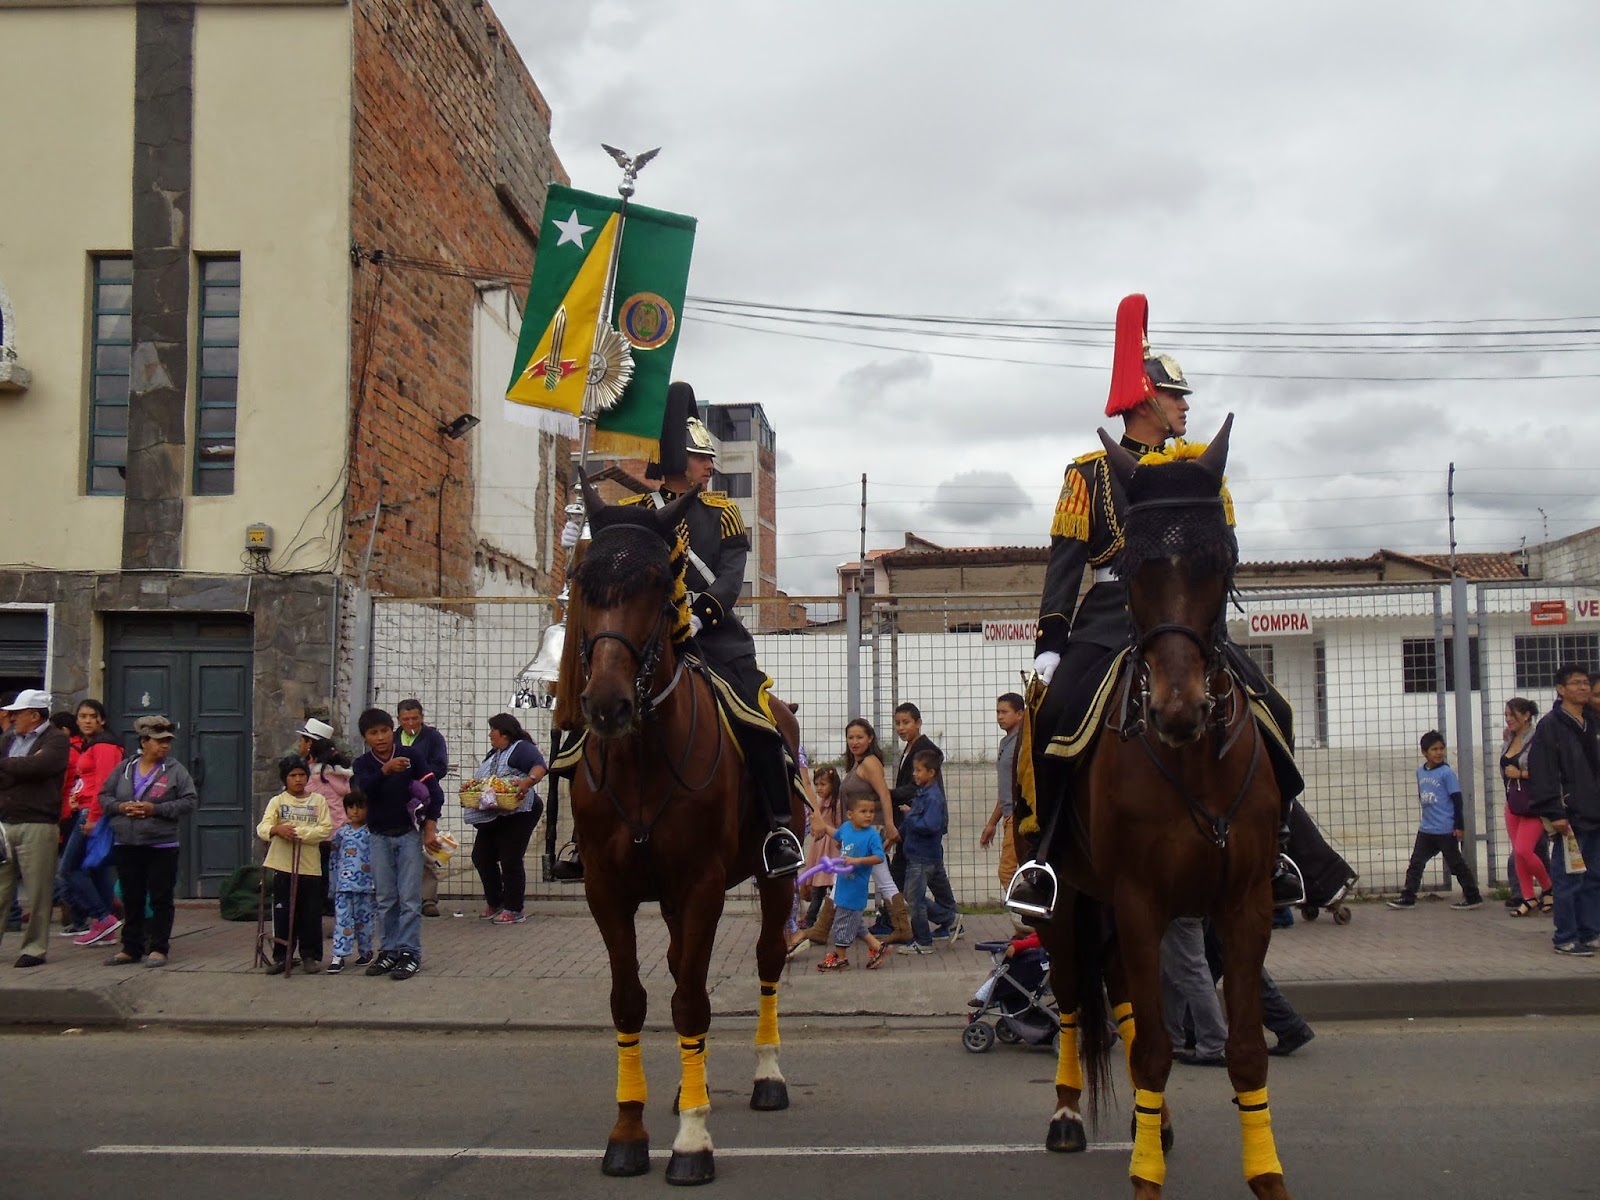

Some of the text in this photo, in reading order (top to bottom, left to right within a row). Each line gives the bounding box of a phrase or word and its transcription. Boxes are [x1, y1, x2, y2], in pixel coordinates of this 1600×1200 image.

[1577, 600, 1599, 617] VE
[1251, 613, 1309, 632] COMPRA
[985, 623, 1038, 640] CONSIGNACIO
